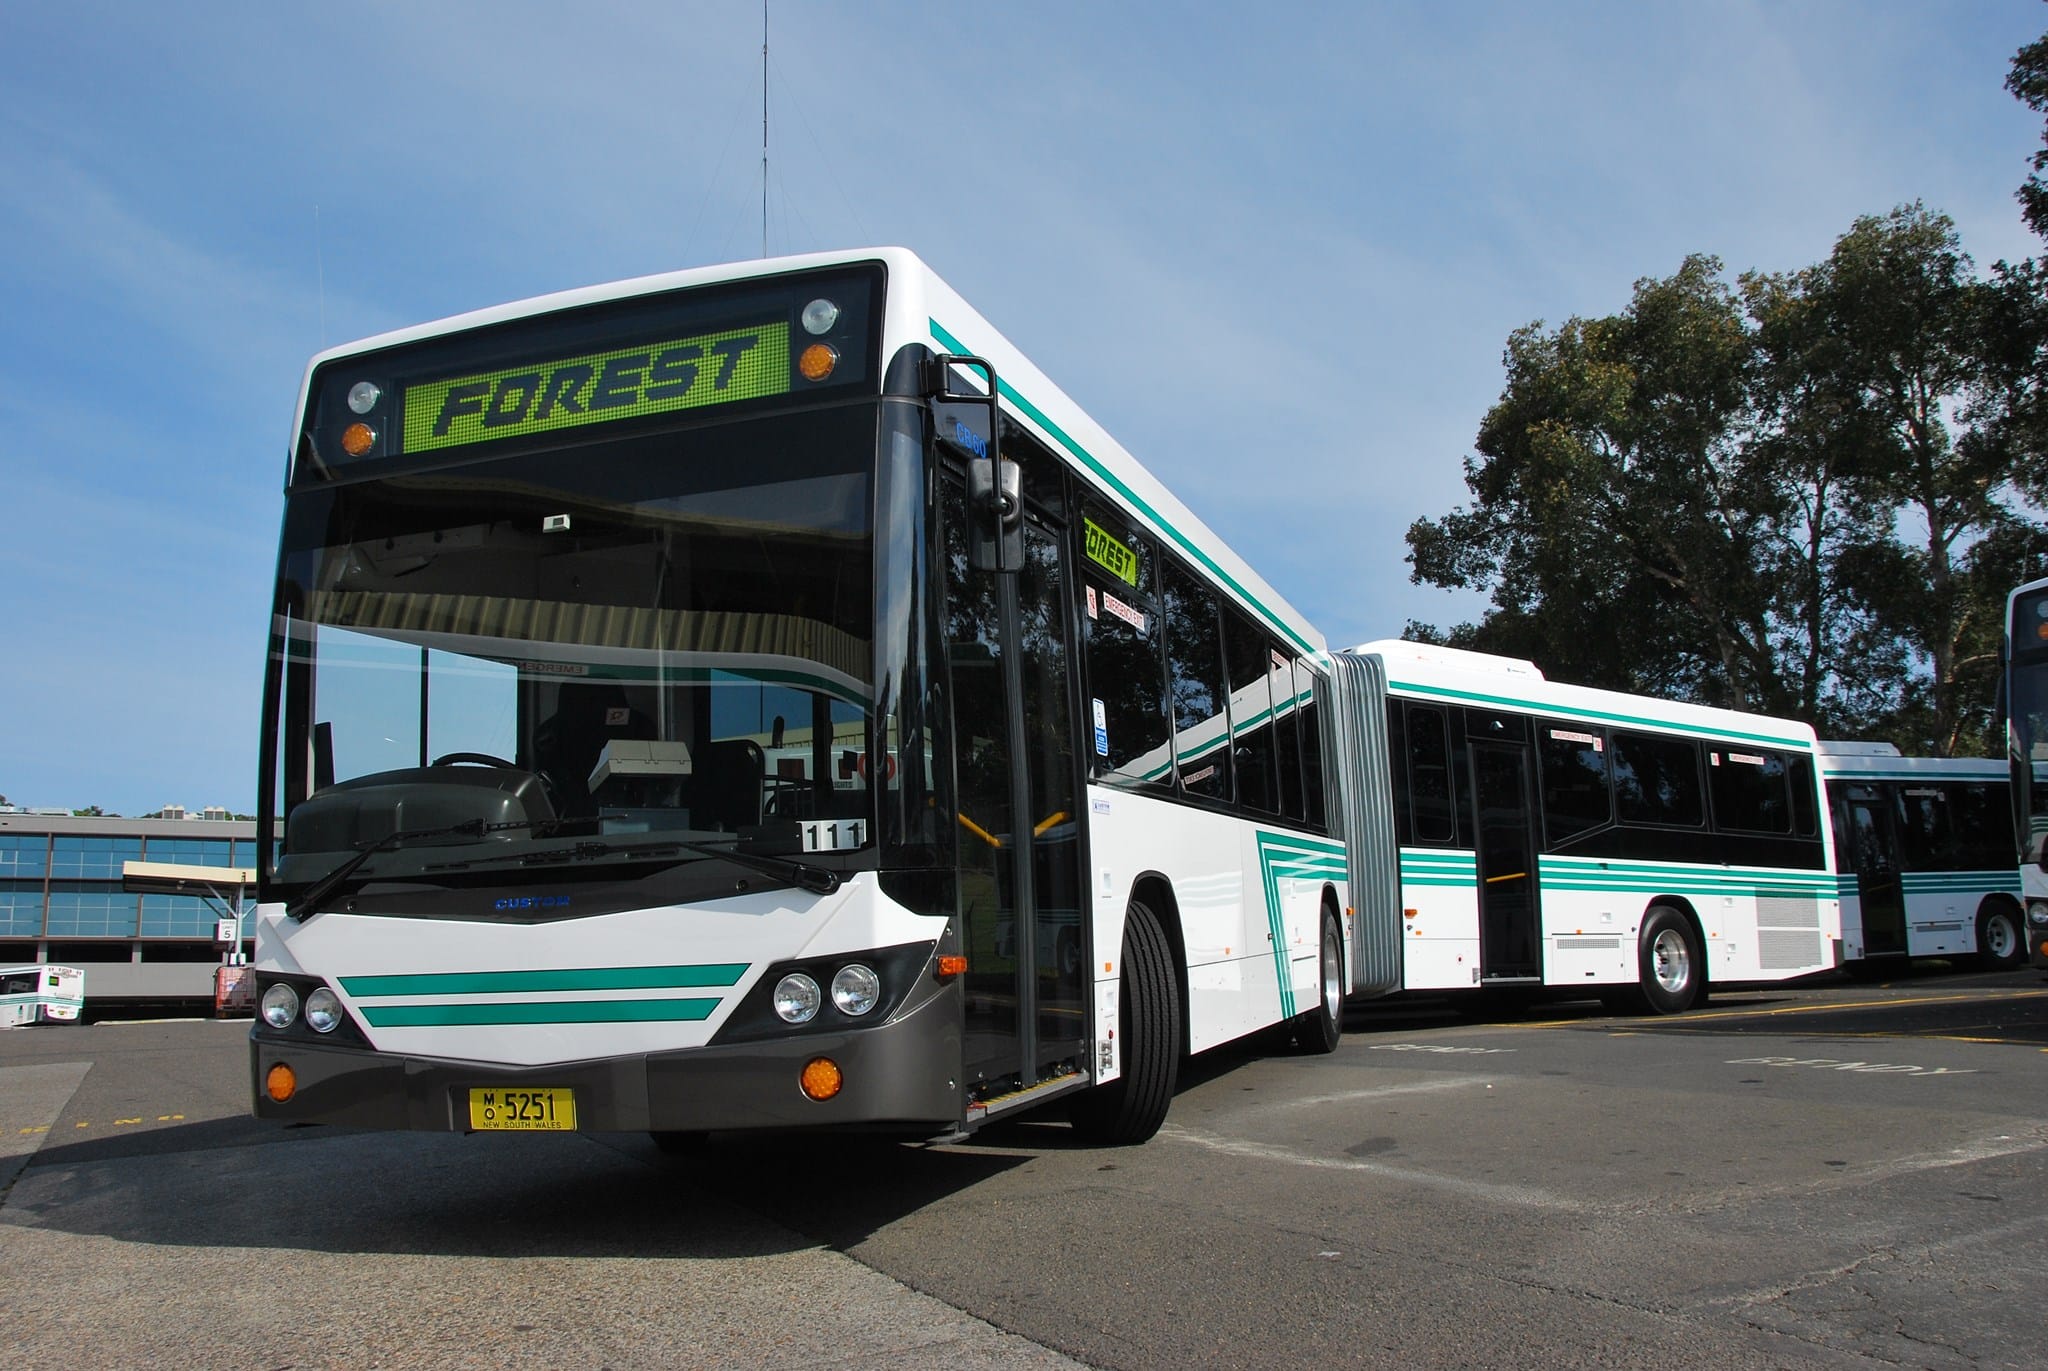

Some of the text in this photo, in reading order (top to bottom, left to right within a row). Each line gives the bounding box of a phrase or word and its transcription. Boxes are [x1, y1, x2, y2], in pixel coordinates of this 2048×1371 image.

[433, 335, 758, 437] FOREST
[807, 822, 859, 850] 111
[495, 895, 570, 910] CUSTOM
[224, 930, 231, 938] 5
[505, 1093, 555, 1120] 5251
